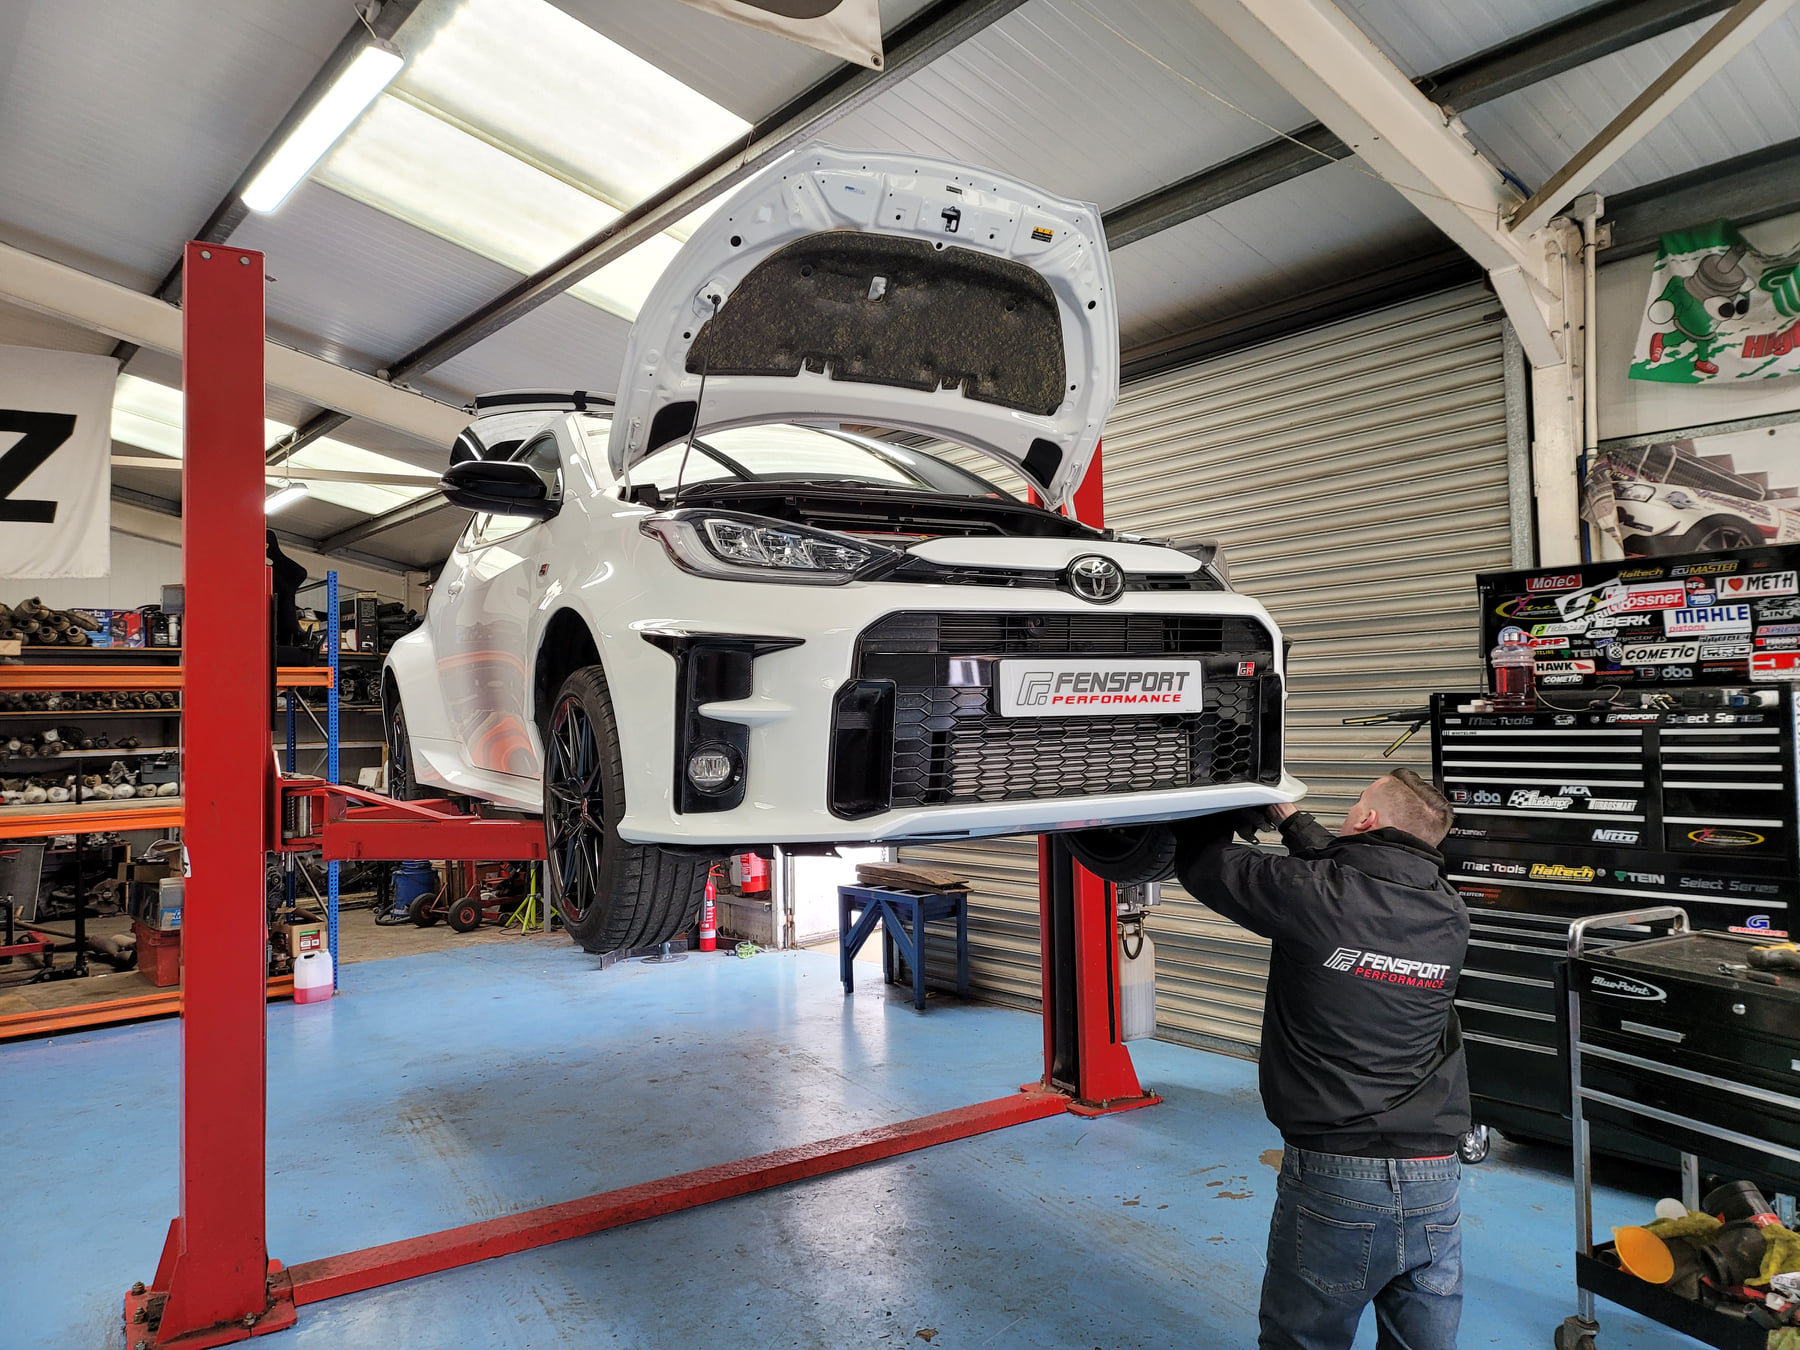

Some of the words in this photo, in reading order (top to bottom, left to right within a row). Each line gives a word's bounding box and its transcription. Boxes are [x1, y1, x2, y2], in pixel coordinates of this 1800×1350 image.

[1532, 576, 1576, 589] MoTeC
[1746, 572, 1794, 591] METH
[1627, 593, 1682, 607] össner
[1675, 605, 1748, 624] MAHLE
[1668, 624, 1705, 633] pistons
[1528, 638, 1566, 648] ARP
[1571, 649, 1604, 657] TEIN
[1626, 645, 1696, 660] COMETIC
[1536, 662, 1573, 672] HAWK
[1054, 671, 1190, 693] FENSPORT
[1544, 674, 1582, 683] COMETIC
[1052, 694, 1182, 705] PERFORMANCE
[1500, 715, 1533, 726] Tools
[1665, 713, 1710, 724] Select
[1714, 712, 1764, 723] Series
[1473, 790, 1501, 803] dba
[1559, 786, 1592, 796] MCA
[1492, 863, 1527, 875] Tools
[1532, 865, 1594, 878] Haltech
[1627, 873, 1665, 885] TEIN
[1679, 877, 1724, 890] Select
[1729, 881, 1779, 893] Series
[1360, 953, 1450, 979] FENSPORT
[1354, 967, 1445, 989] PERFORMANCE
